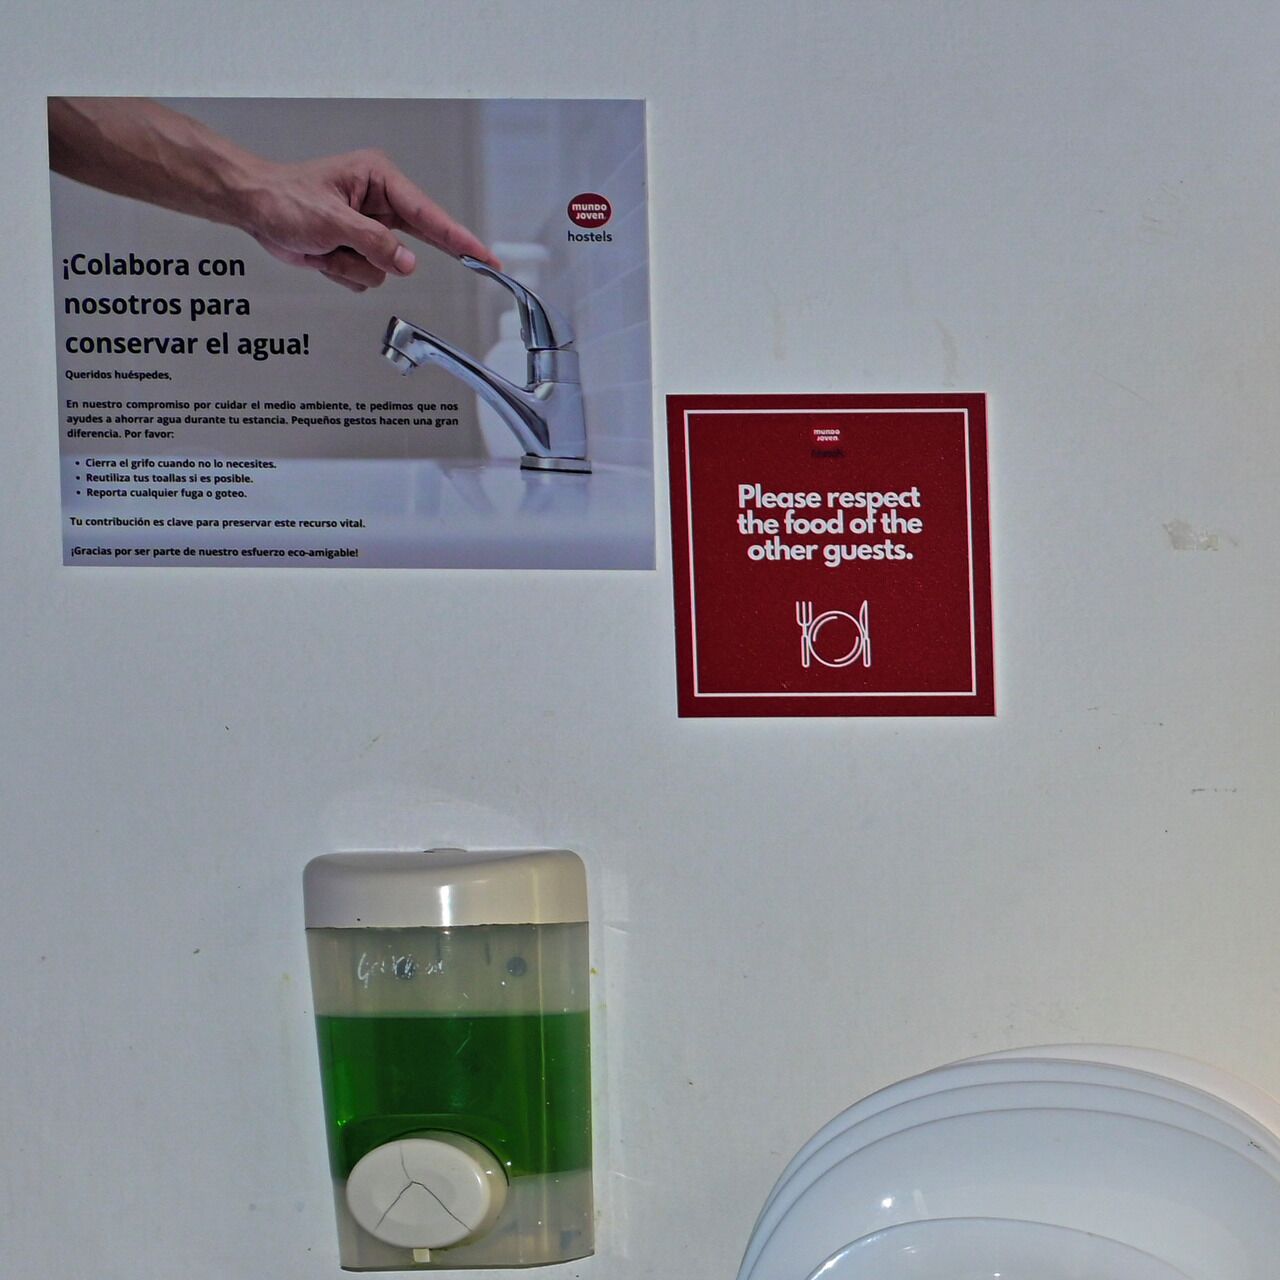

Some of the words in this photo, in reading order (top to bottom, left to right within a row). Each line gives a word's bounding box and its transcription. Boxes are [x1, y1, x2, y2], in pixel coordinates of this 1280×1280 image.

[567, 230, 613, 242] hostels
[62, 252, 189, 280] ¡Colabora
[198, 259, 244, 276] con
[64, 294, 181, 315] nosotros
[190, 298, 250, 322] para
[65, 335, 198, 355] conservar
[206, 331, 228, 354] el
[237, 332, 309, 361] agua!
[65, 369, 112, 381] Queridos
[114, 369, 171, 382] huéspedes,
[66, 399, 78, 408] En
[82, 400, 122, 408] nuestro
[125, 399, 190, 411] compromiso
[193, 401, 211, 411] por
[214, 400, 247, 409] cuidar
[250, 399, 260, 409] el
[263, 400, 296, 409] medio
[299, 400, 351, 411] ambiente,
[355, 402, 366, 410] te
[369, 401, 413, 413] pedimos
[417, 403, 436, 413] que
[85, 458, 116, 467] Cierra
[119, 458, 128, 467] el
[130, 458, 155, 470] grifo
[157, 458, 195, 468] cuando
[198, 460, 211, 468] no
[213, 458, 223, 468] lo
[225, 458, 276, 468] necesites.
[86, 472, 130, 482] Reutiliza
[133, 474, 149, 482] tus
[152, 473, 186, 482] toallas
[188, 473, 197, 482] si
[213, 473, 253, 485] posible.
[86, 487, 127, 499] Reporta
[129, 487, 178, 499] cualquier
[180, 488, 203, 500] fuga
[214, 489, 247, 500] goteo.
[738, 483, 821, 508] Please
[827, 486, 920, 511] respect
[69, 516, 82, 526] Tu
[85, 516, 150, 526] contribución
[166, 517, 193, 527] clave
[196, 519, 219, 529] para
[222, 519, 272, 529] preservar
[274, 519, 296, 527] este
[339, 518, 365, 527] vital.
[736, 509, 780, 534] the
[783, 509, 844, 534] food
[849, 509, 877, 534] of
[880, 509, 922, 534] the
[71, 546, 112, 557] ¡Gracias
[114, 548, 132, 558] por
[134, 548, 150, 556] ser
[152, 547, 180, 558] parte
[183, 546, 196, 556] de
[198, 548, 238, 556] nuestro
[241, 547, 285, 556] esfuerzo
[287, 547, 358, 559] eco-amigable!
[747, 535, 818, 560] other
[823, 539, 913, 567] guests.
